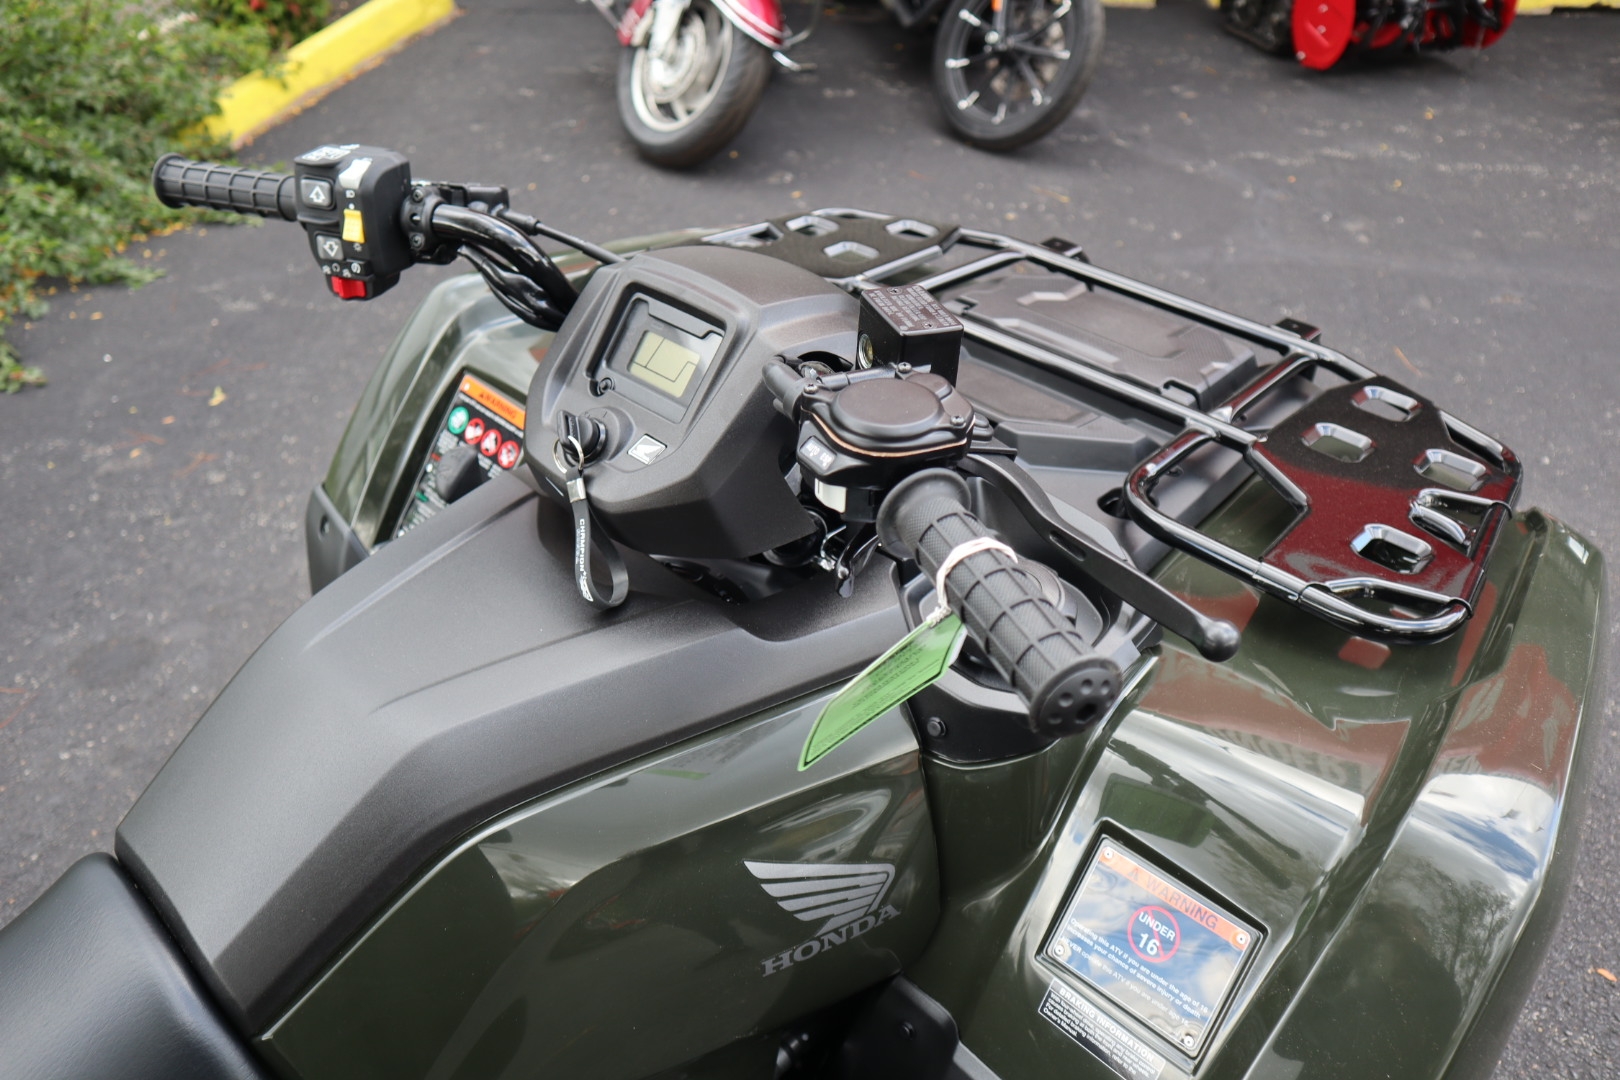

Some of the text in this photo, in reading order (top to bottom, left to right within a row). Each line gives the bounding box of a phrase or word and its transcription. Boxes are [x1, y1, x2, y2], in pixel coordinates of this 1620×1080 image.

[1144, 876, 1219, 929] WARNING
[762, 905, 901, 977] HONDA
[1136, 932, 1160, 956] 16
[1138, 912, 1176, 941] UNDER
[1066, 925, 1093, 946] increases
[1093, 944, 1106, 956] your
[1107, 952, 1126, 968] chance
[1136, 973, 1156, 988] severe
[1156, 986, 1174, 1001] injury
[1069, 918, 1098, 940] Operating
[1098, 936, 1110, 947] this
[1109, 944, 1122, 955] ATV
[1127, 957, 1139, 968] you
[1139, 965, 1149, 975] are
[1150, 971, 1168, 986] under
[1168, 983, 1179, 994] the
[1178, 992, 1191, 1003] age
[1191, 999, 1199, 1007] of
[1199, 1005, 1208, 1013] 16
[1045, 1002, 1054, 1011] For
[1112, 971, 1125, 982] ATV
[1129, 984, 1140, 994] you
[1141, 991, 1149, 999] are
[1151, 997, 1167, 1011] under
[1043, 1007, 1061, 1023] Owner's
[1059, 987, 1154, 1062] BRAKING INFORMATION
